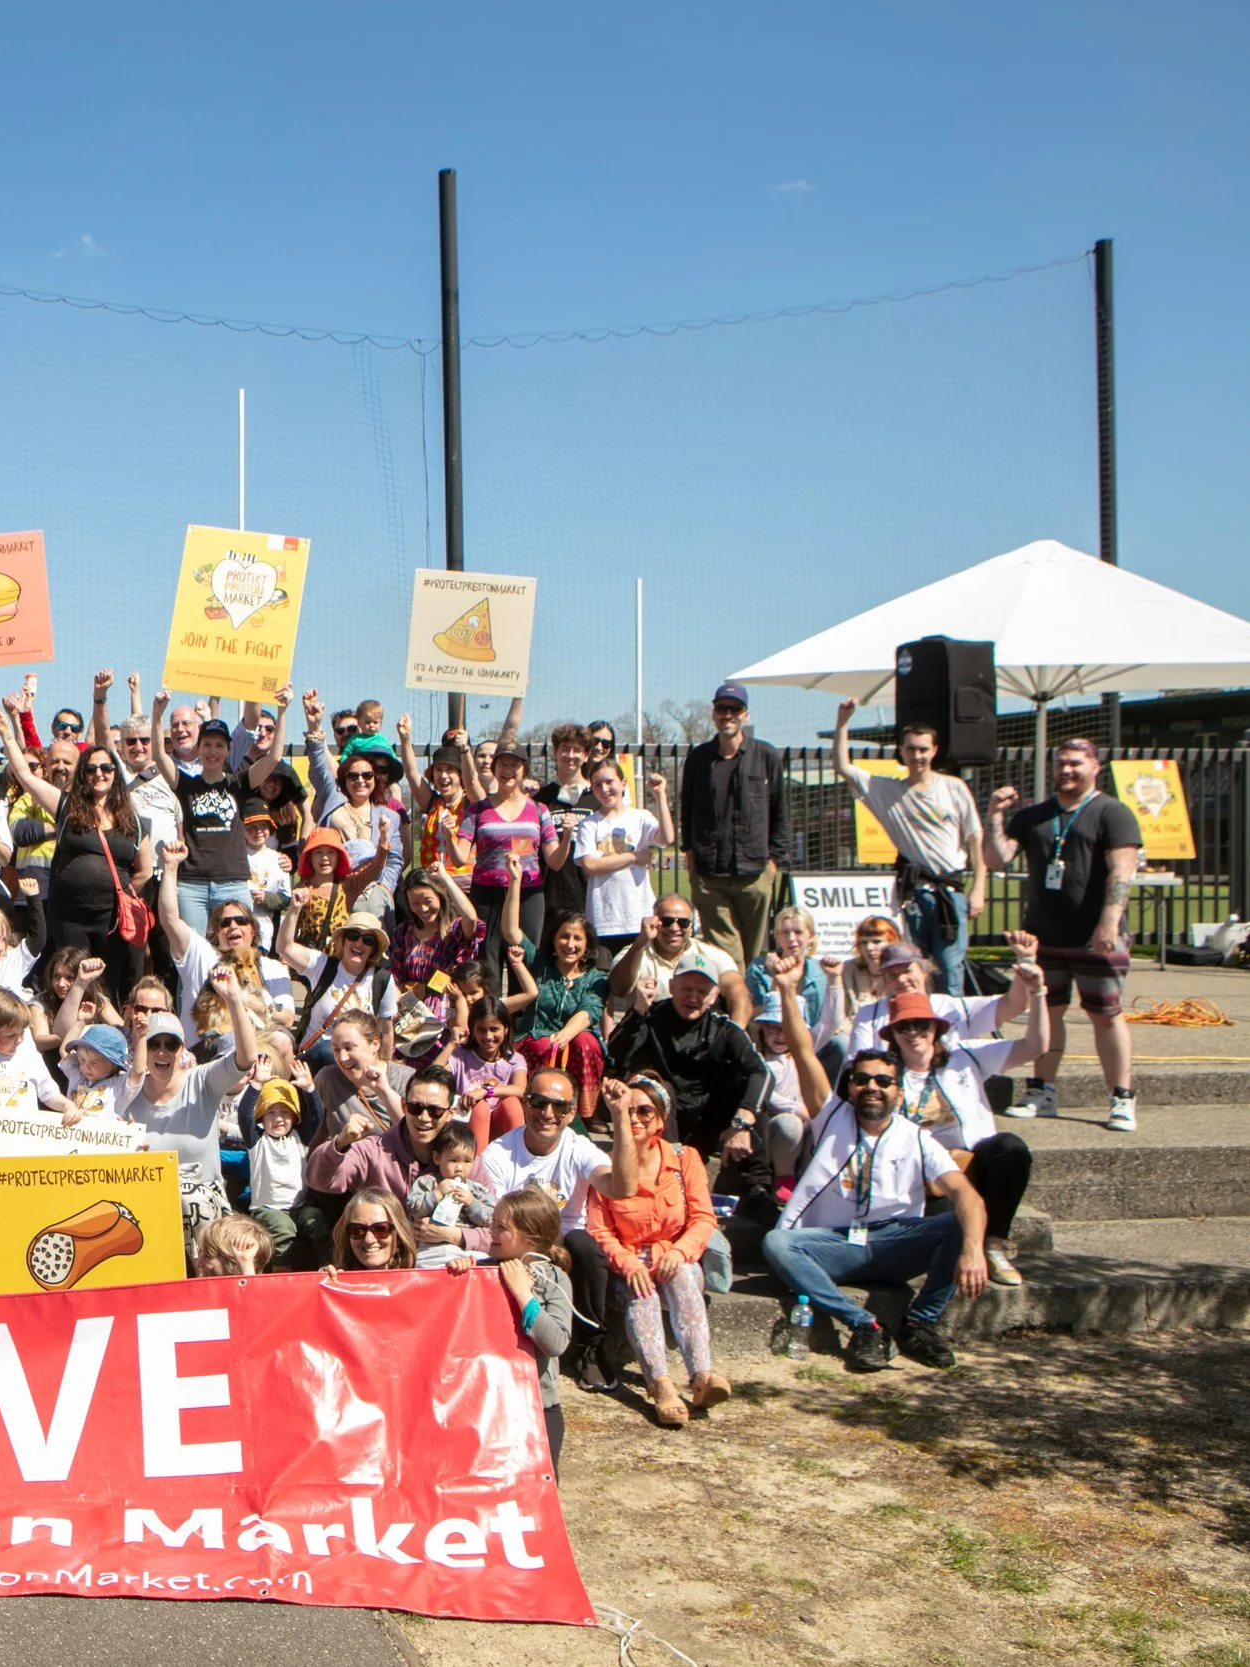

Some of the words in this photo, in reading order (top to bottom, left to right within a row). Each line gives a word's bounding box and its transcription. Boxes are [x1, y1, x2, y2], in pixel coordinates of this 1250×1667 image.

[226, 570, 268, 584] PROTECT
[224, 582, 265, 595] PRESTON
[423, 579, 526, 596] #PROTECTPRESTONMARKET
[223, 593, 263, 607] MARKET
[6, 636, 16, 647] UP
[215, 636, 240, 654] THE
[436, 665, 458, 675] PIZZA
[462, 667, 474, 676] THE
[803, 887, 890, 908] SMILE!
[124, 1496, 546, 1570] Market
